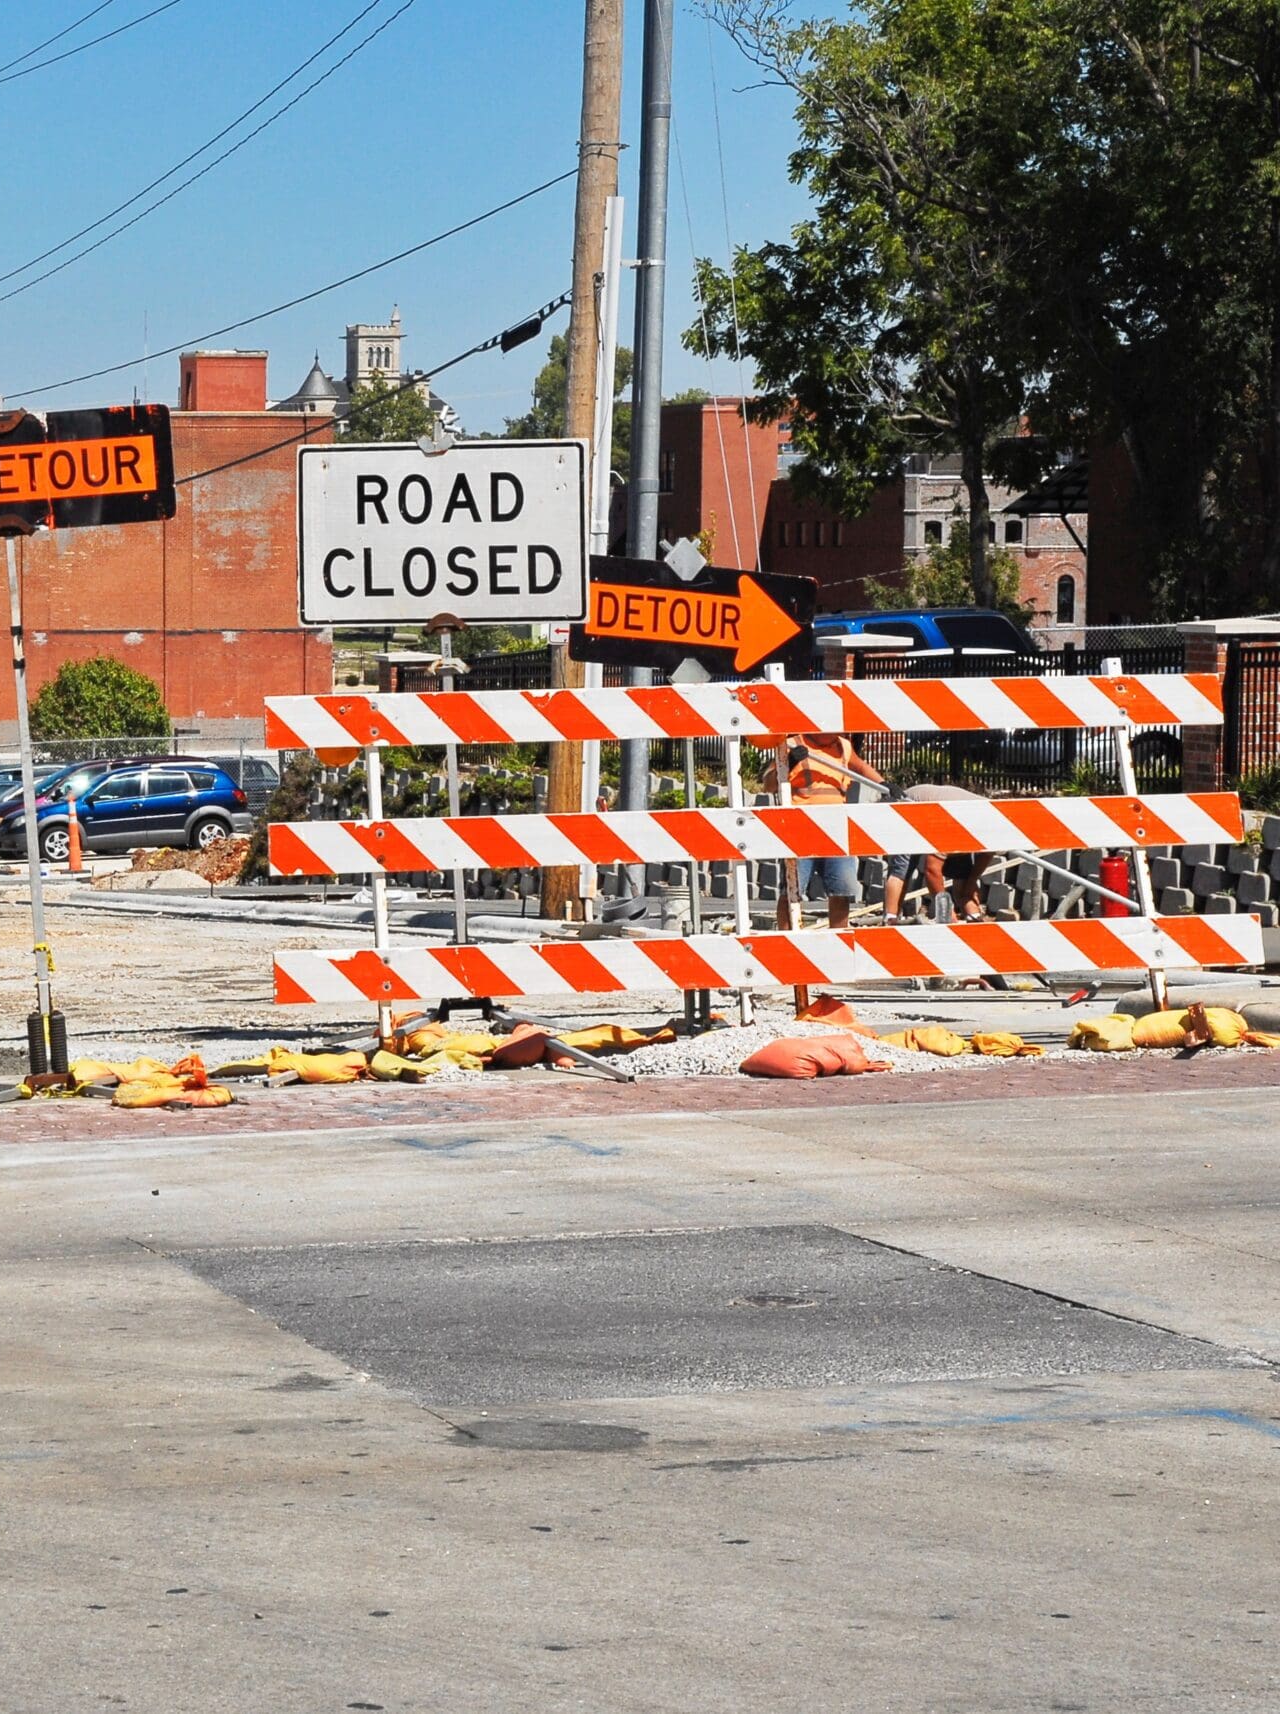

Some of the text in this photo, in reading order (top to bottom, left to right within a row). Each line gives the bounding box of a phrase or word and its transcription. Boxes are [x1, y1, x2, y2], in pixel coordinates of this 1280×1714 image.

[356, 472, 524, 525] ROAD
[322, 544, 562, 598] CLOSED
[596, 591, 741, 641] DETOUR
